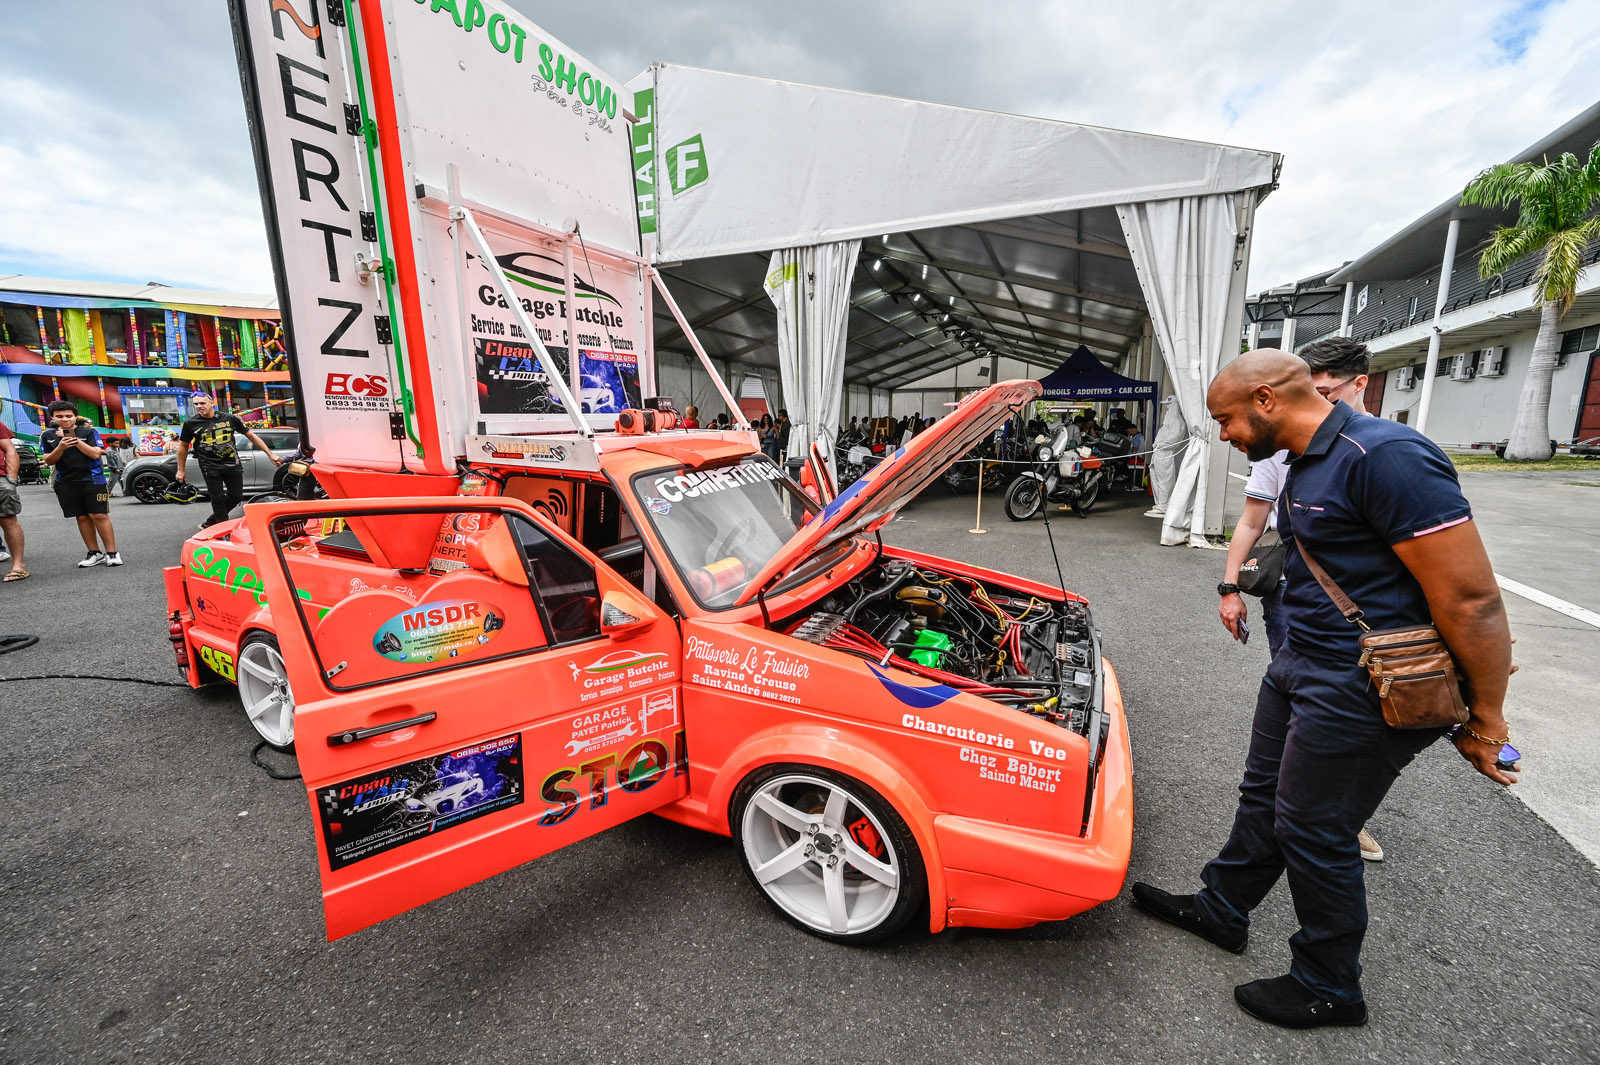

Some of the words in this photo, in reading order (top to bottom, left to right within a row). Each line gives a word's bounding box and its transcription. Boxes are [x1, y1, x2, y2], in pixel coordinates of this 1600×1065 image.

[414, 0, 526, 63] APOT
[538, 43, 617, 119] SHOW
[572, 100, 583, 117] &
[635, 104, 654, 218] HALL
[677, 143, 700, 189] F
[478, 285, 555, 319] Gaage
[471, 314, 505, 336] Service
[485, 341, 533, 359] Clean
[623, 354, 637, 363] 650
[1043, 388, 1070, 396] TOROILS
[1077, 387, 1112, 396] ADDITIVES
[1134, 386, 1152, 394] CARE
[655, 462, 785, 502] COMPETITION
[402, 602, 482, 631] MSDR
[410, 626, 436, 638] 0693
[456, 619, 475, 629] 774
[200, 644, 237, 682] 46
[584, 672, 625, 688] Garage
[627, 661, 668, 678] Butchle
[740, 646, 757, 675] Le
[761, 650, 809, 679] Fraisier
[692, 674, 760, 696] Saint-André
[762, 690, 778, 701] 0692
[704, 664, 745, 681] Ravine
[753, 674, 796, 691] Creuse
[580, 691, 598, 701] Service
[571, 725, 599, 739] PAYET
[601, 716, 631, 731] Patrick
[572, 705, 627, 728] GARAGE
[456, 747, 480, 758] 0692
[481, 742, 497, 751] 302
[498, 737, 516, 746] 650
[585, 744, 600, 753] 0692
[902, 713, 1014, 749] Charcuterie
[1029, 740, 1067, 761] Vee
[959, 747, 997, 768] Chez
[1006, 757, 1062, 782] Bebert
[340, 777, 391, 799] Clean
[979, 766, 1017, 785] Sainte
[1019, 775, 1057, 793] Marie
[335, 842, 354, 853] PAYET
[356, 828, 394, 846] CHRISTOPHE
